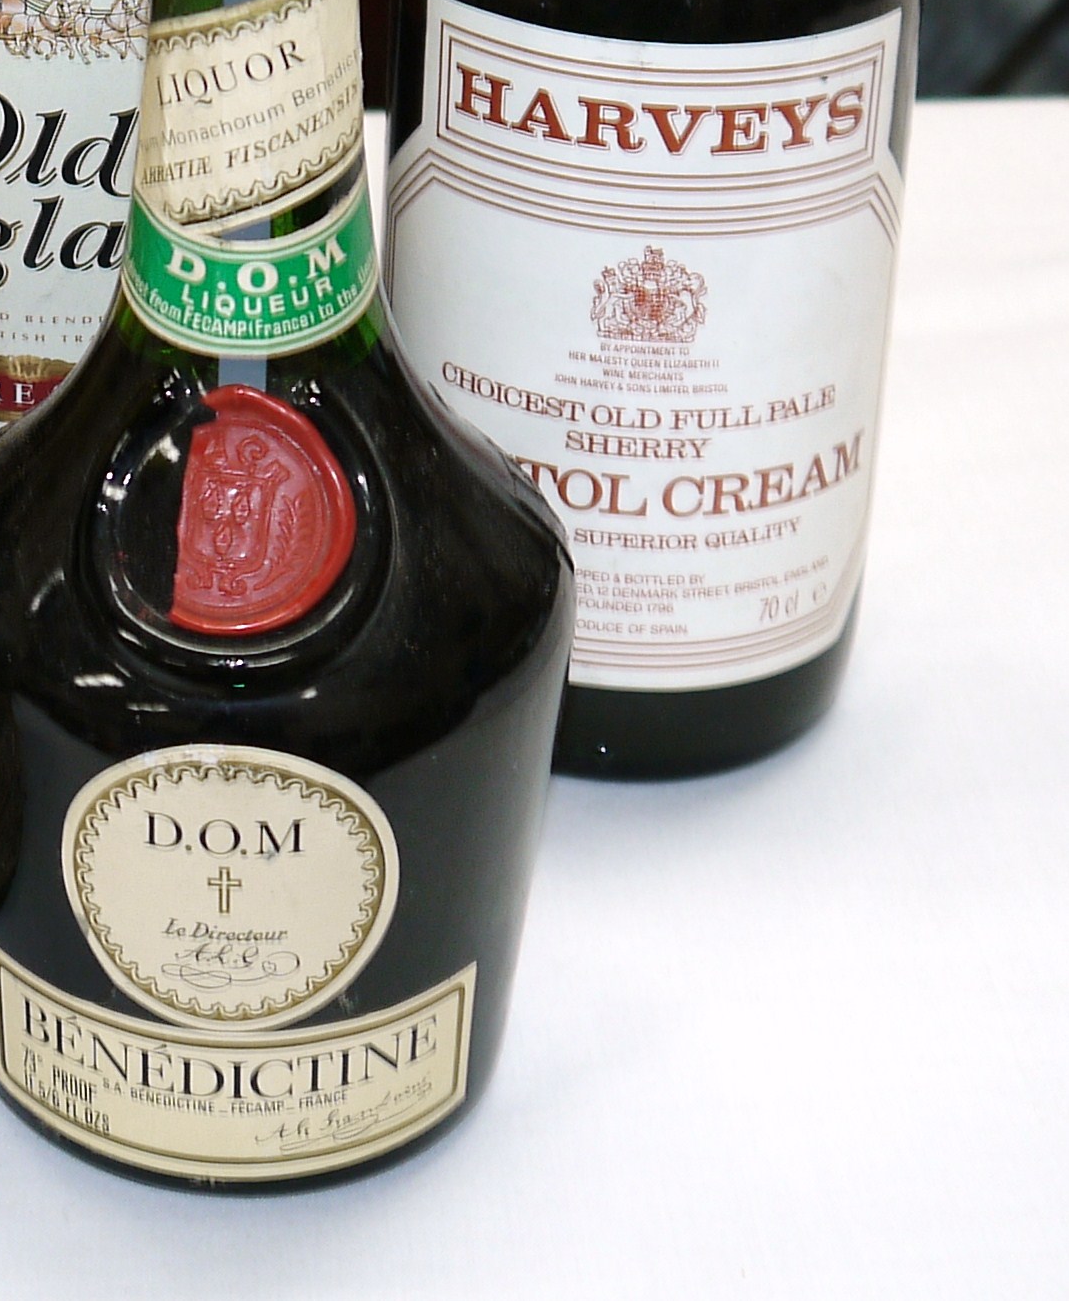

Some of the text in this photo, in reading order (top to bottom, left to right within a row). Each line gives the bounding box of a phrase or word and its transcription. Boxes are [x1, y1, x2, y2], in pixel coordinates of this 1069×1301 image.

[156, 39, 305, 108] LIQUOR
[162, 103, 286, 145] Monachorum
[454, 60, 865, 156] HARVEYS
[164, 235, 346, 294] D.O.M
[149, 288, 182, 323] from
[318, 302, 335, 319] to
[336, 284, 358, 309] the
[181, 277, 333, 317] LIQUEUR
[569, 350, 586, 361] HER
[589, 353, 628, 366] MAJESTY
[630, 359, 661, 368] QUEEN
[663, 359, 711, 369] ELIZABETH
[600, 343, 690, 356] BY APPOINTMENT TO
[554, 373, 577, 385] JOHN
[580, 378, 615, 391] HARVEY
[617, 382, 623, 391] &
[626, 383, 651, 393] SONS
[692, 383, 728, 394] BRISTOL
[602, 368, 684, 381] WINE MERCHANTS
[442, 361, 837, 431] CHOICEST OLD FULL PALE
[565, 429, 712, 459] SHERRY
[662, 428, 865, 518] CREAM
[573, 516, 802, 550] SUPERIOR QUALITY
[598, 586, 609, 596] 12
[612, 587, 678, 599] DENMARK
[682, 585, 730, 599] STREET
[734, 576, 779, 594] BRISTOL
[624, 573, 686, 586] BOTTLED
[690, 574, 706, 585] BY
[578, 597, 643, 613] FOUNDED
[760, 595, 780, 621] 70
[628, 624, 648, 634] OF
[650, 624, 688, 635] SPAIN
[143, 810, 306, 857] D.O.M
[160, 917, 289, 941] Le Directeur
[21, 993, 438, 1099] BÉNÉDICTINE
[52, 1065, 97, 1105] PROOF
[298, 1089, 348, 1110] FRANCE
